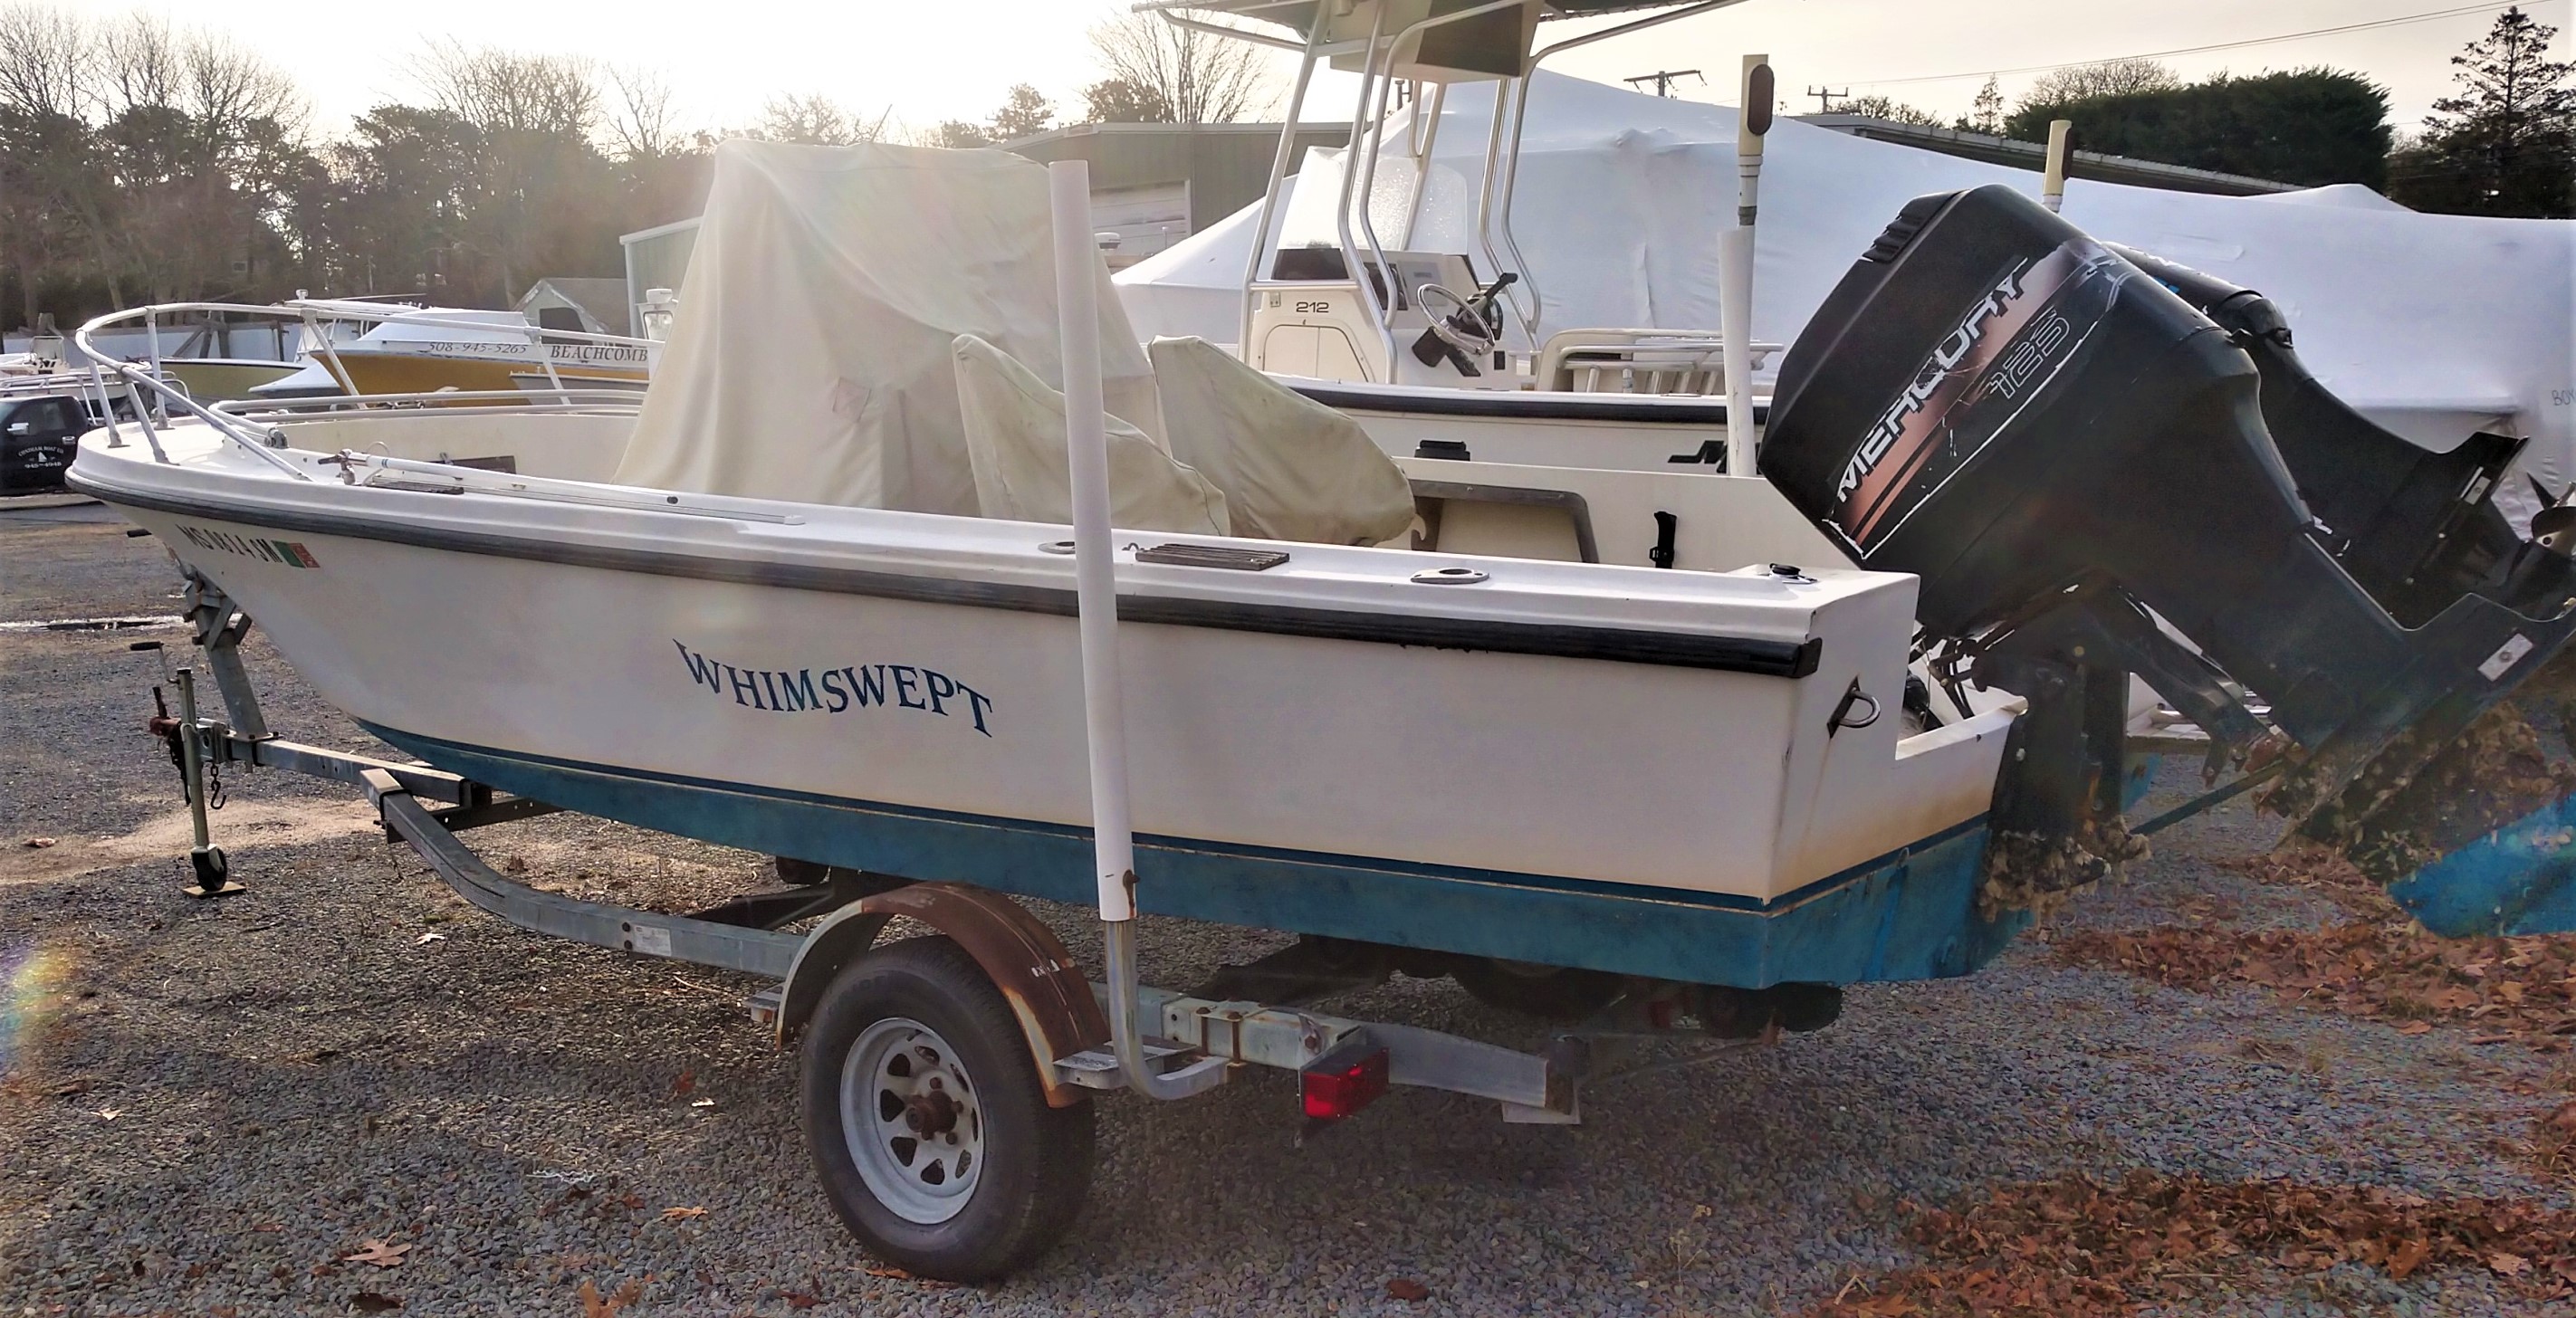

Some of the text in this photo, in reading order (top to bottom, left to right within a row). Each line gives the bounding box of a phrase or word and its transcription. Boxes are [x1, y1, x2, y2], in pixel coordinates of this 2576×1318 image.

[1296, 301, 1329, 313] 212
[429, 342, 527, 354] 508-945-5265
[1837, 257, 2029, 503] MERCURY
[1985, 305, 2071, 399] 125
[175, 523, 215, 550] MS
[249, 538, 283, 563] SM
[672, 638, 993, 738] WHIMSWEPT
